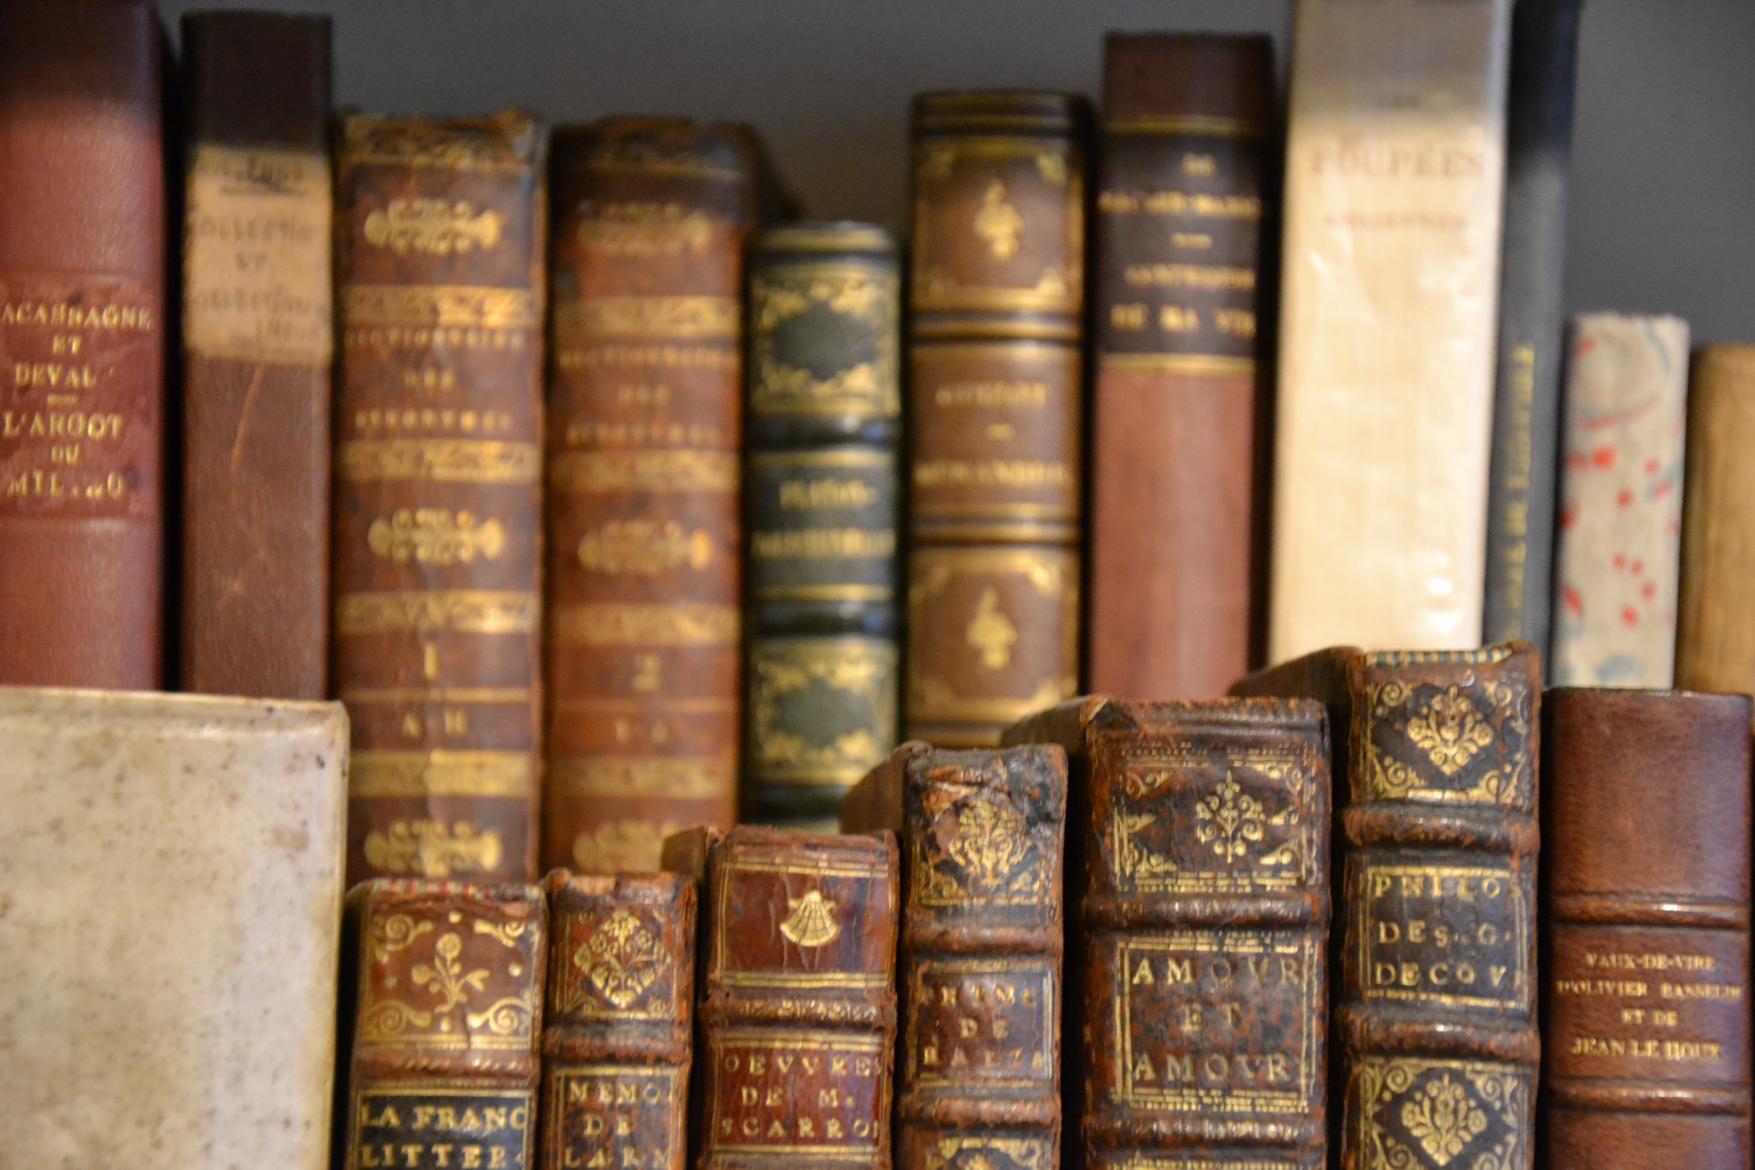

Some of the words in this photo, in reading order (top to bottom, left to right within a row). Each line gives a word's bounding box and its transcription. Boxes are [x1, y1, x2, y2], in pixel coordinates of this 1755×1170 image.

[1132, 957, 1300, 986] AMOVR
[1184, 1002, 1243, 1032] ET
[1621, 1009, 1644, 1025] ET
[1653, 1010, 1678, 1026] DE
[959, 1018, 1010, 1039] DE
[1571, 1037, 1626, 1057] JEAN
[741, 1086, 784, 1106] DE
[361, 1104, 401, 1128] LA
[583, 1113, 633, 1137] DE
